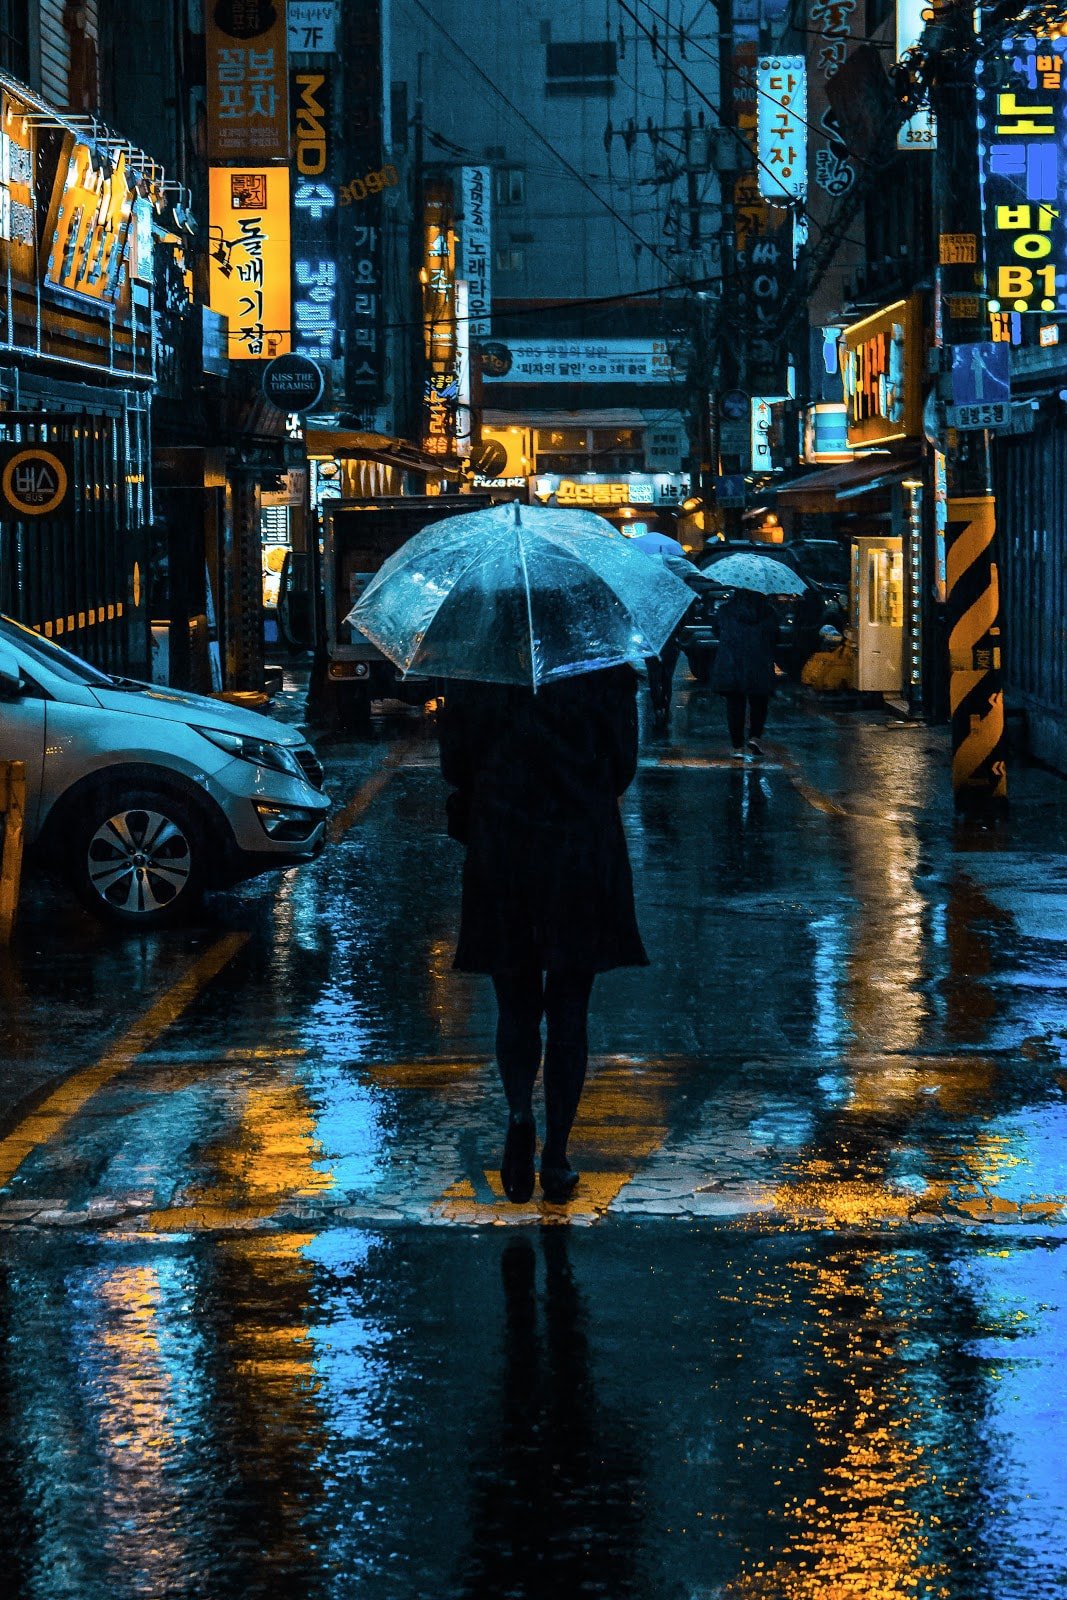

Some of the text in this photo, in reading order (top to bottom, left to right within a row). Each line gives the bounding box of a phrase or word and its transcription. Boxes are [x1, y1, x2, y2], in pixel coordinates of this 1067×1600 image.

[301, 27, 323, 48] 7F
[218, 84, 280, 119] 포차
[770, 74, 798, 178] 당구장
[989, 93, 1061, 260] 노래방
[228, 217, 268, 356] 돌배기집
[998, 264, 1057, 298] B1
[270, 382, 316, 391] TIRAMISU
[271, 372, 315, 382] KISS THE
[15, 466, 56, 493] 버스
[473, 475, 506, 488] Pizza
[25, 494, 44, 502] BUS
